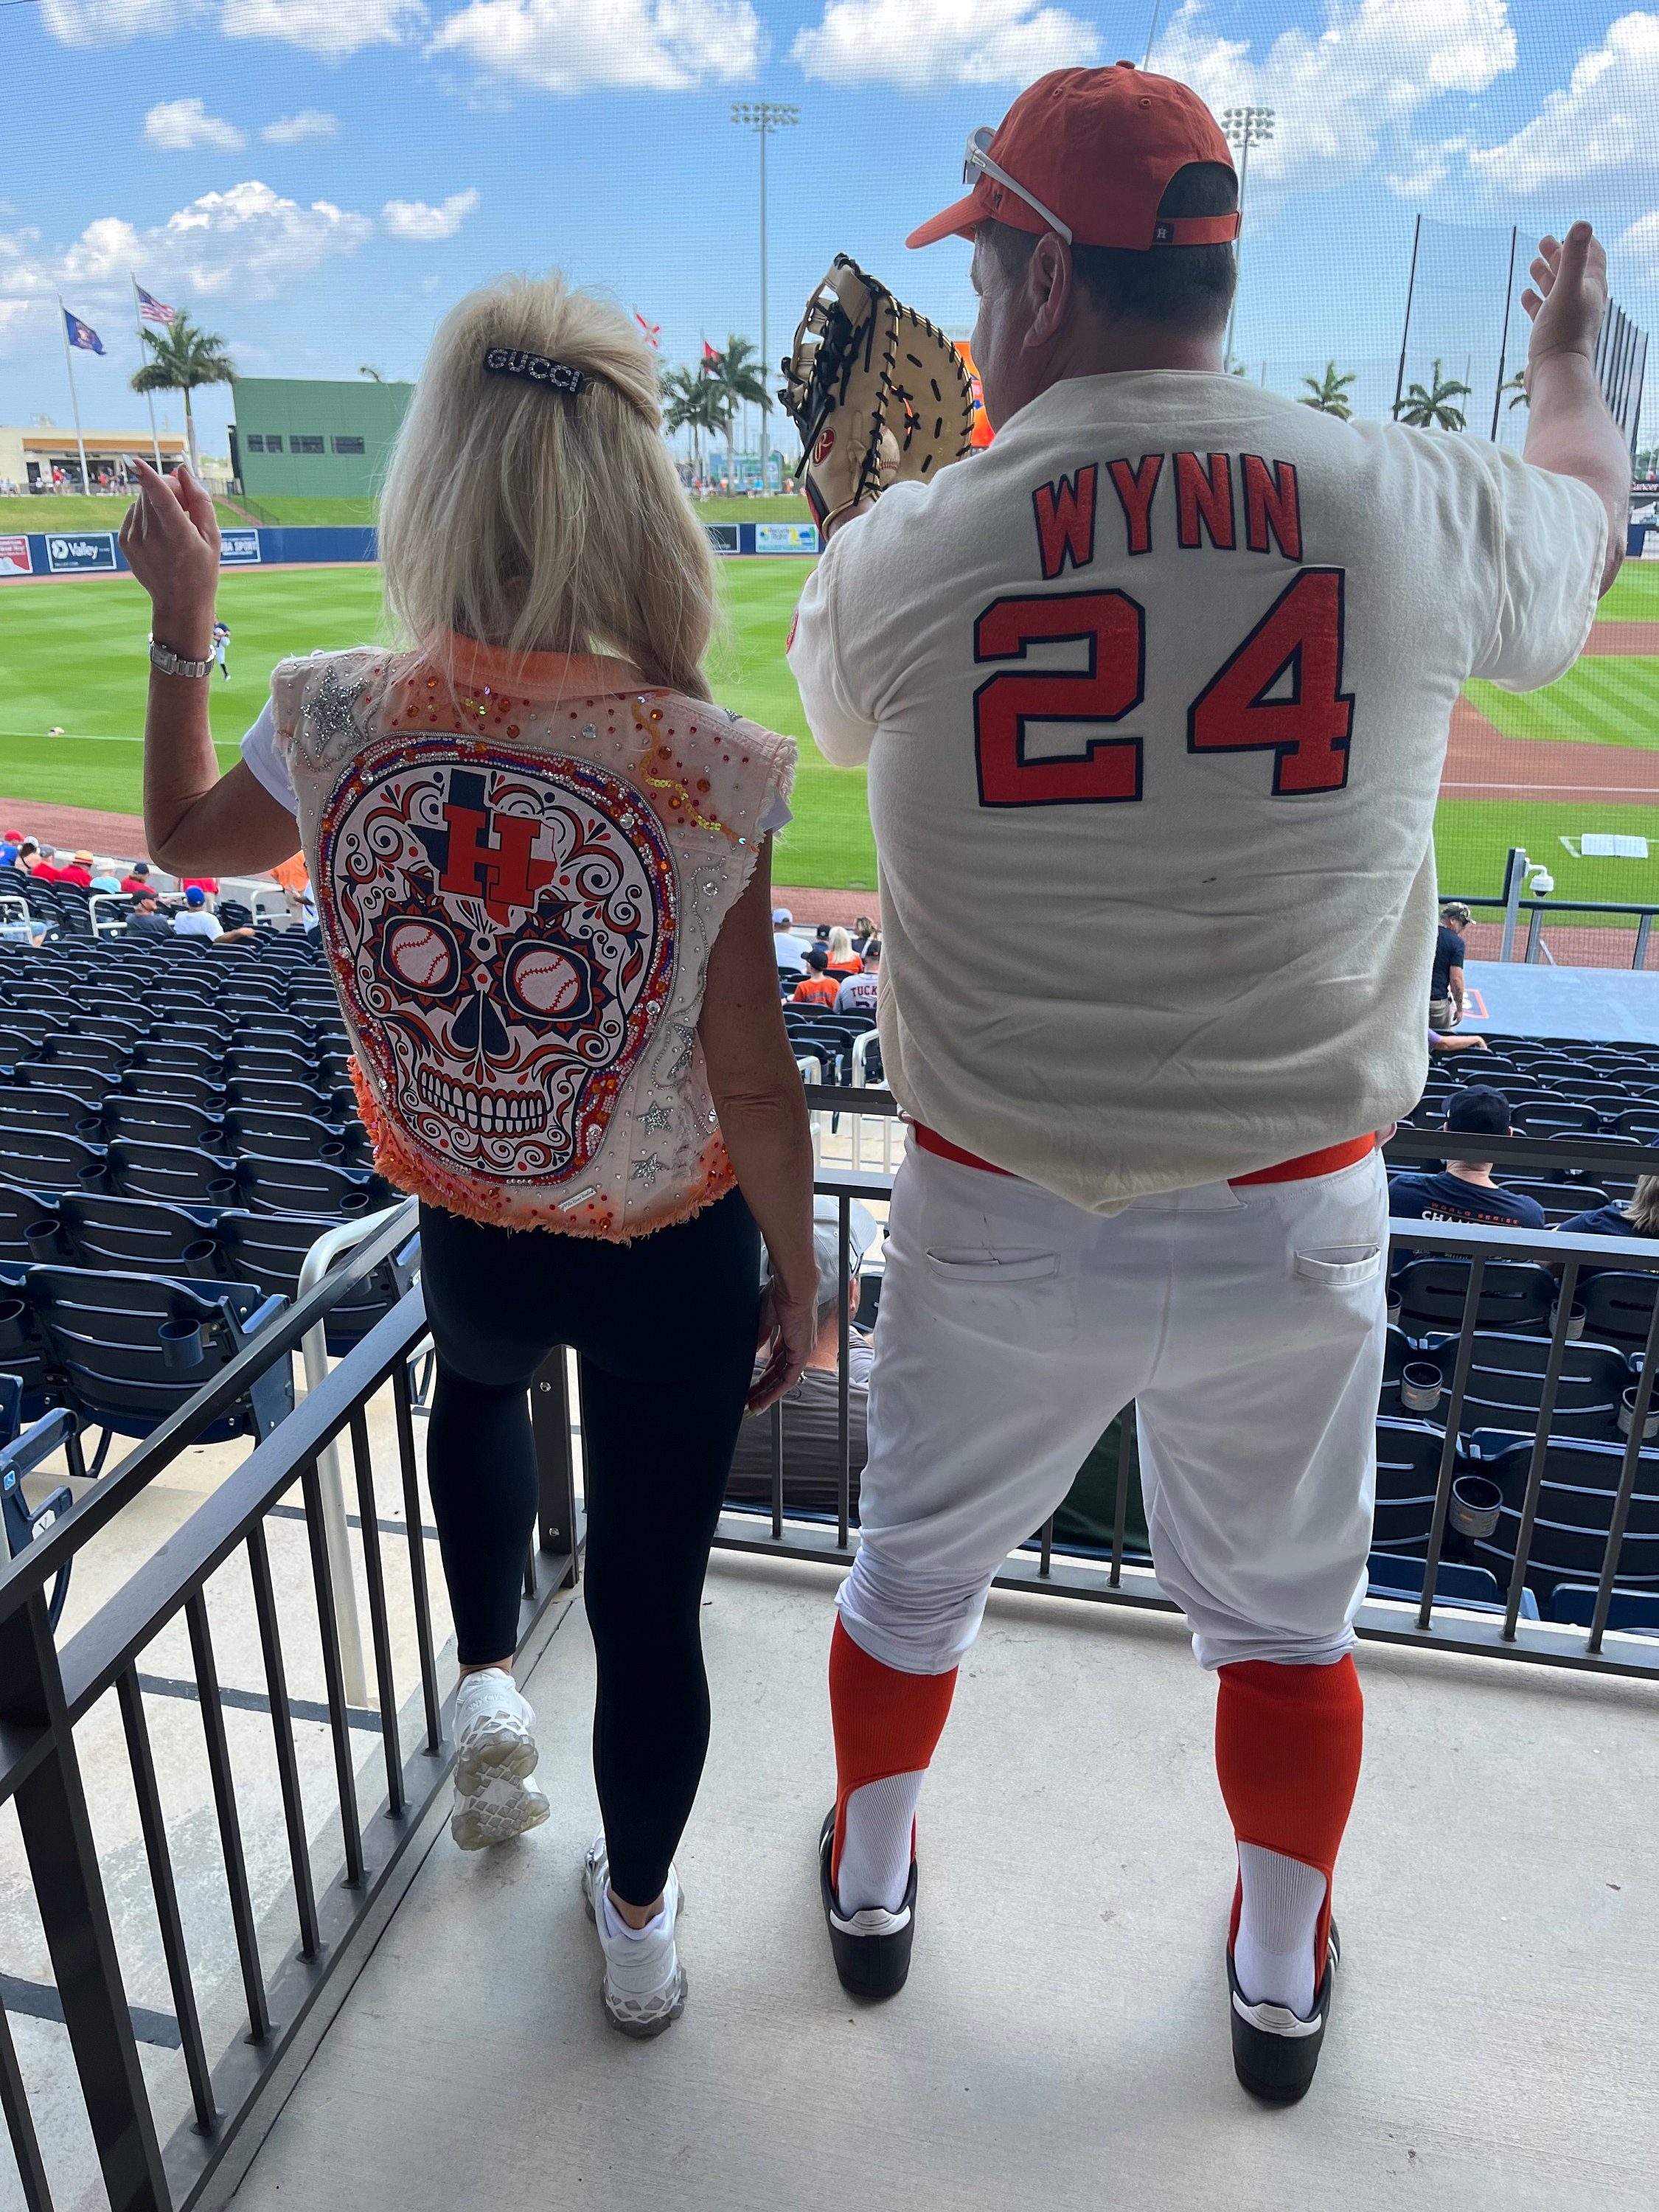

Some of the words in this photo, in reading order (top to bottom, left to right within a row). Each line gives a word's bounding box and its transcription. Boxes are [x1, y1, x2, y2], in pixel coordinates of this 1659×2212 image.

[488, 349, 580, 392] GUCCI
[1032, 451, 1303, 580] WYNN
[68, 541, 98, 560] Valley
[973, 568, 1355, 807] 24
[1431, 1202, 1471, 1217] WORLD
[1478, 1212, 1519, 1225] SERIES
